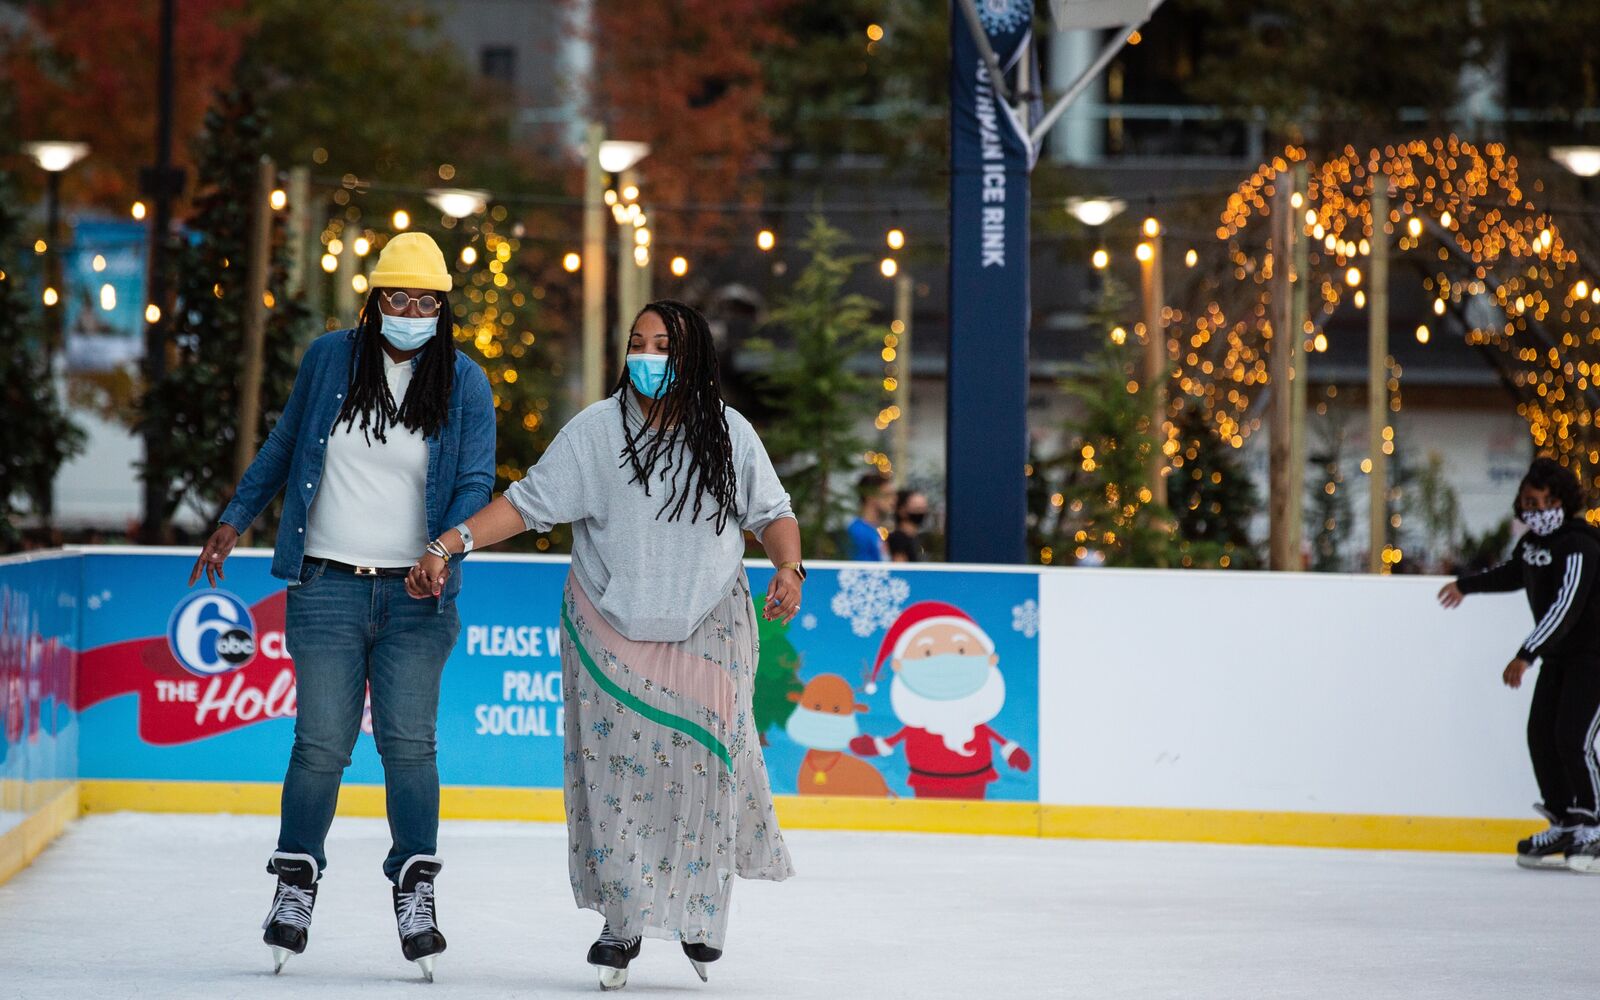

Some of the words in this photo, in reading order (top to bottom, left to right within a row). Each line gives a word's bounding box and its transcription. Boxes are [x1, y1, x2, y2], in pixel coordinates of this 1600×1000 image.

[982, 164, 1006, 203] ICE
[981, 206, 1006, 268] RINK
[176, 594, 240, 674] 6
[217, 633, 255, 655] abc
[466, 624, 543, 657] PLEASE
[154, 680, 199, 703] THE
[502, 670, 565, 702] PRAC
[474, 703, 552, 737] SOCIAL
